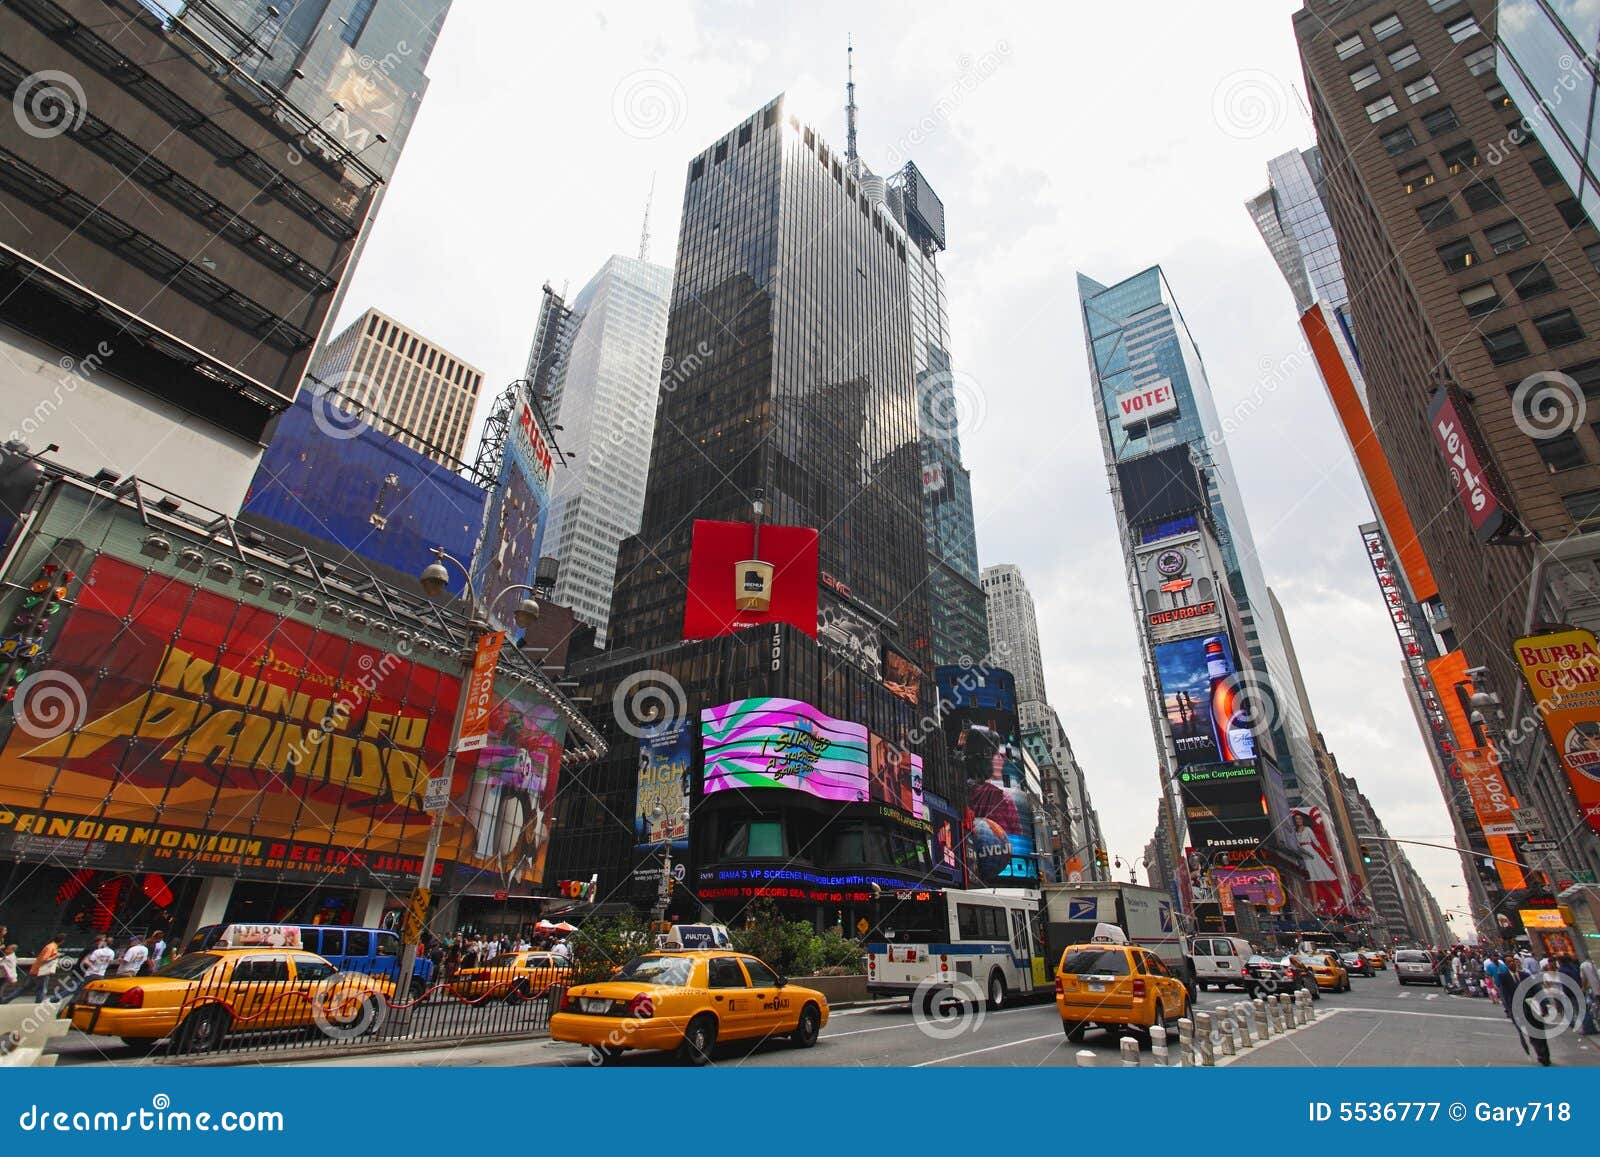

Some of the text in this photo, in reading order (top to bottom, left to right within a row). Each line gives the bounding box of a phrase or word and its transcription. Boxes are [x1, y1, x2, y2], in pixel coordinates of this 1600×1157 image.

[1121, 386, 1171, 415] VOTE!
[520, 402, 553, 479] RUSH
[822, 571, 853, 600] GMC
[1150, 602, 1215, 626] CHEVROLET
[771, 623, 781, 672] 1500
[1518, 641, 1598, 667] BUBBA
[1535, 664, 1600, 689] GUMP
[153, 643, 429, 749] KUNG FU
[476, 663, 497, 721] YOGA
[17, 690, 443, 817] PANDA
[1178, 740, 1216, 751] ULTRA
[431, 778, 449, 787] NYPD
[639, 762, 685, 786] HIGH
[1191, 772, 1210, 781] News
[1211, 767, 1257, 779] Corporation
[1482, 773, 1511, 813] YOGA
[1520, 810, 1531, 819] NO
[1207, 836, 1260, 847] Panasonic
[154, 847, 348, 876] IN THEATRES AND IN IMAX
[268, 842, 367, 868] BEGINS
[750, 869, 761, 879] VP
[1217, 872, 1277, 887] YAHOO!
[233, 925, 282, 935] NYLON
[685, 932, 712, 941] NAUTICA
